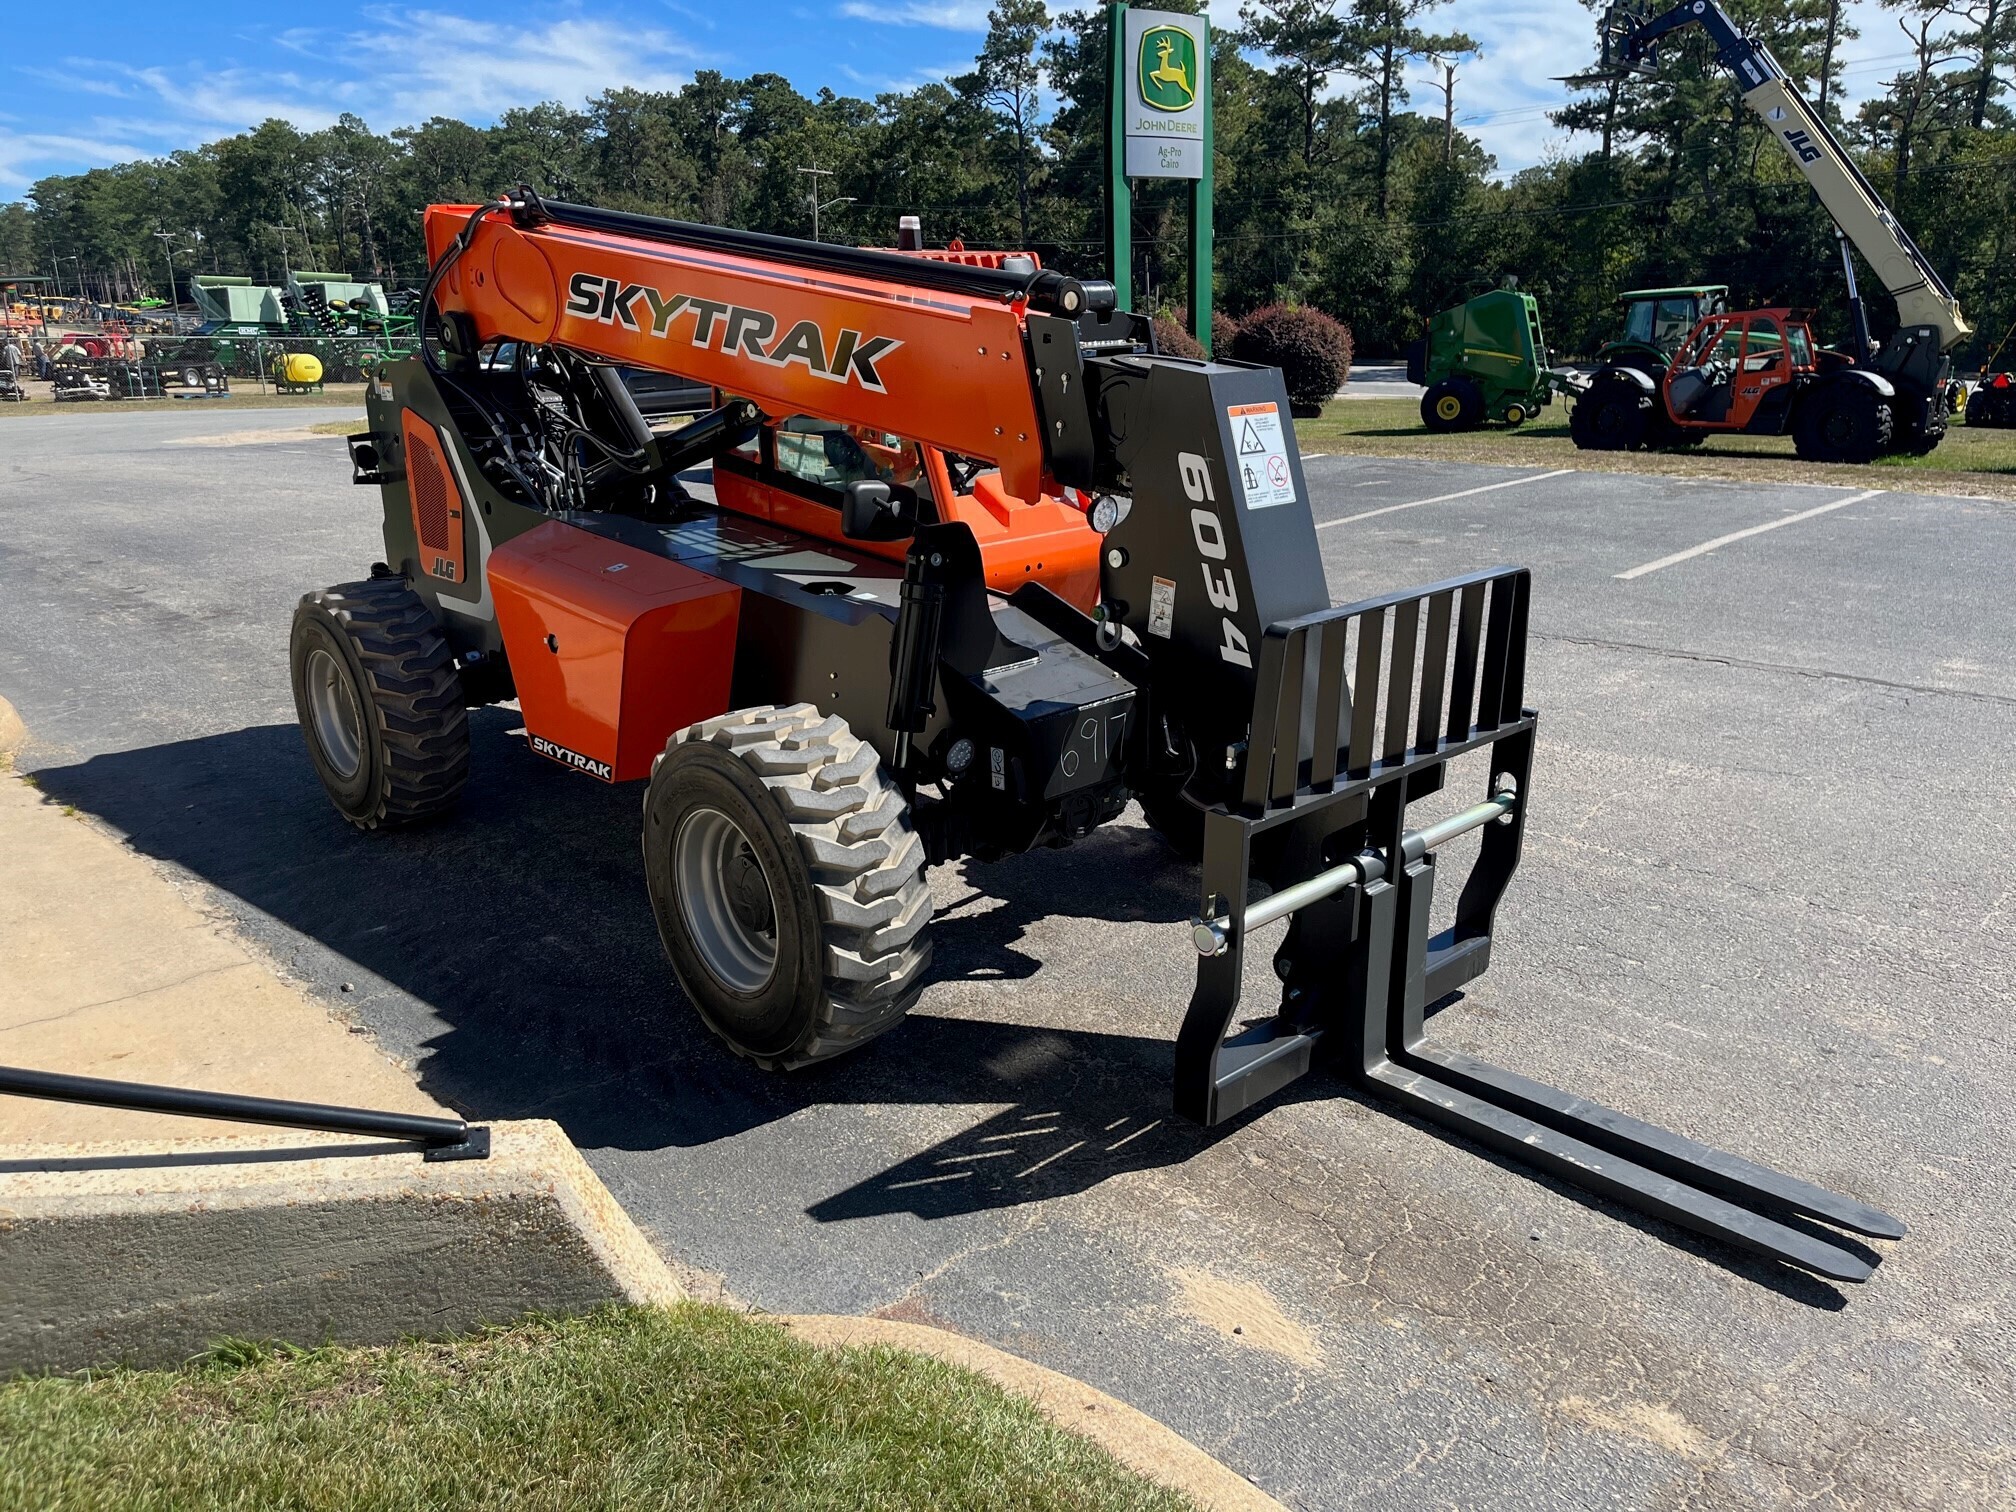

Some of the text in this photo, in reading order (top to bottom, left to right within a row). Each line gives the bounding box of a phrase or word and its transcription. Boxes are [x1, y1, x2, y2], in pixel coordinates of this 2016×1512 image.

[1135, 117, 1198, 133] JOHN DEERE
[1157, 145, 1182, 158] Ag-Pro
[1782, 129, 1822, 164] JLG
[1160, 158, 1180, 168] Cairo
[565, 272, 906, 395] SKYTRAK
[1740, 386, 1761, 394] JLG
[432, 556, 456, 582] JLG
[1177, 451, 1253, 669] 6034
[533, 737, 611, 779] SKYTRAK
